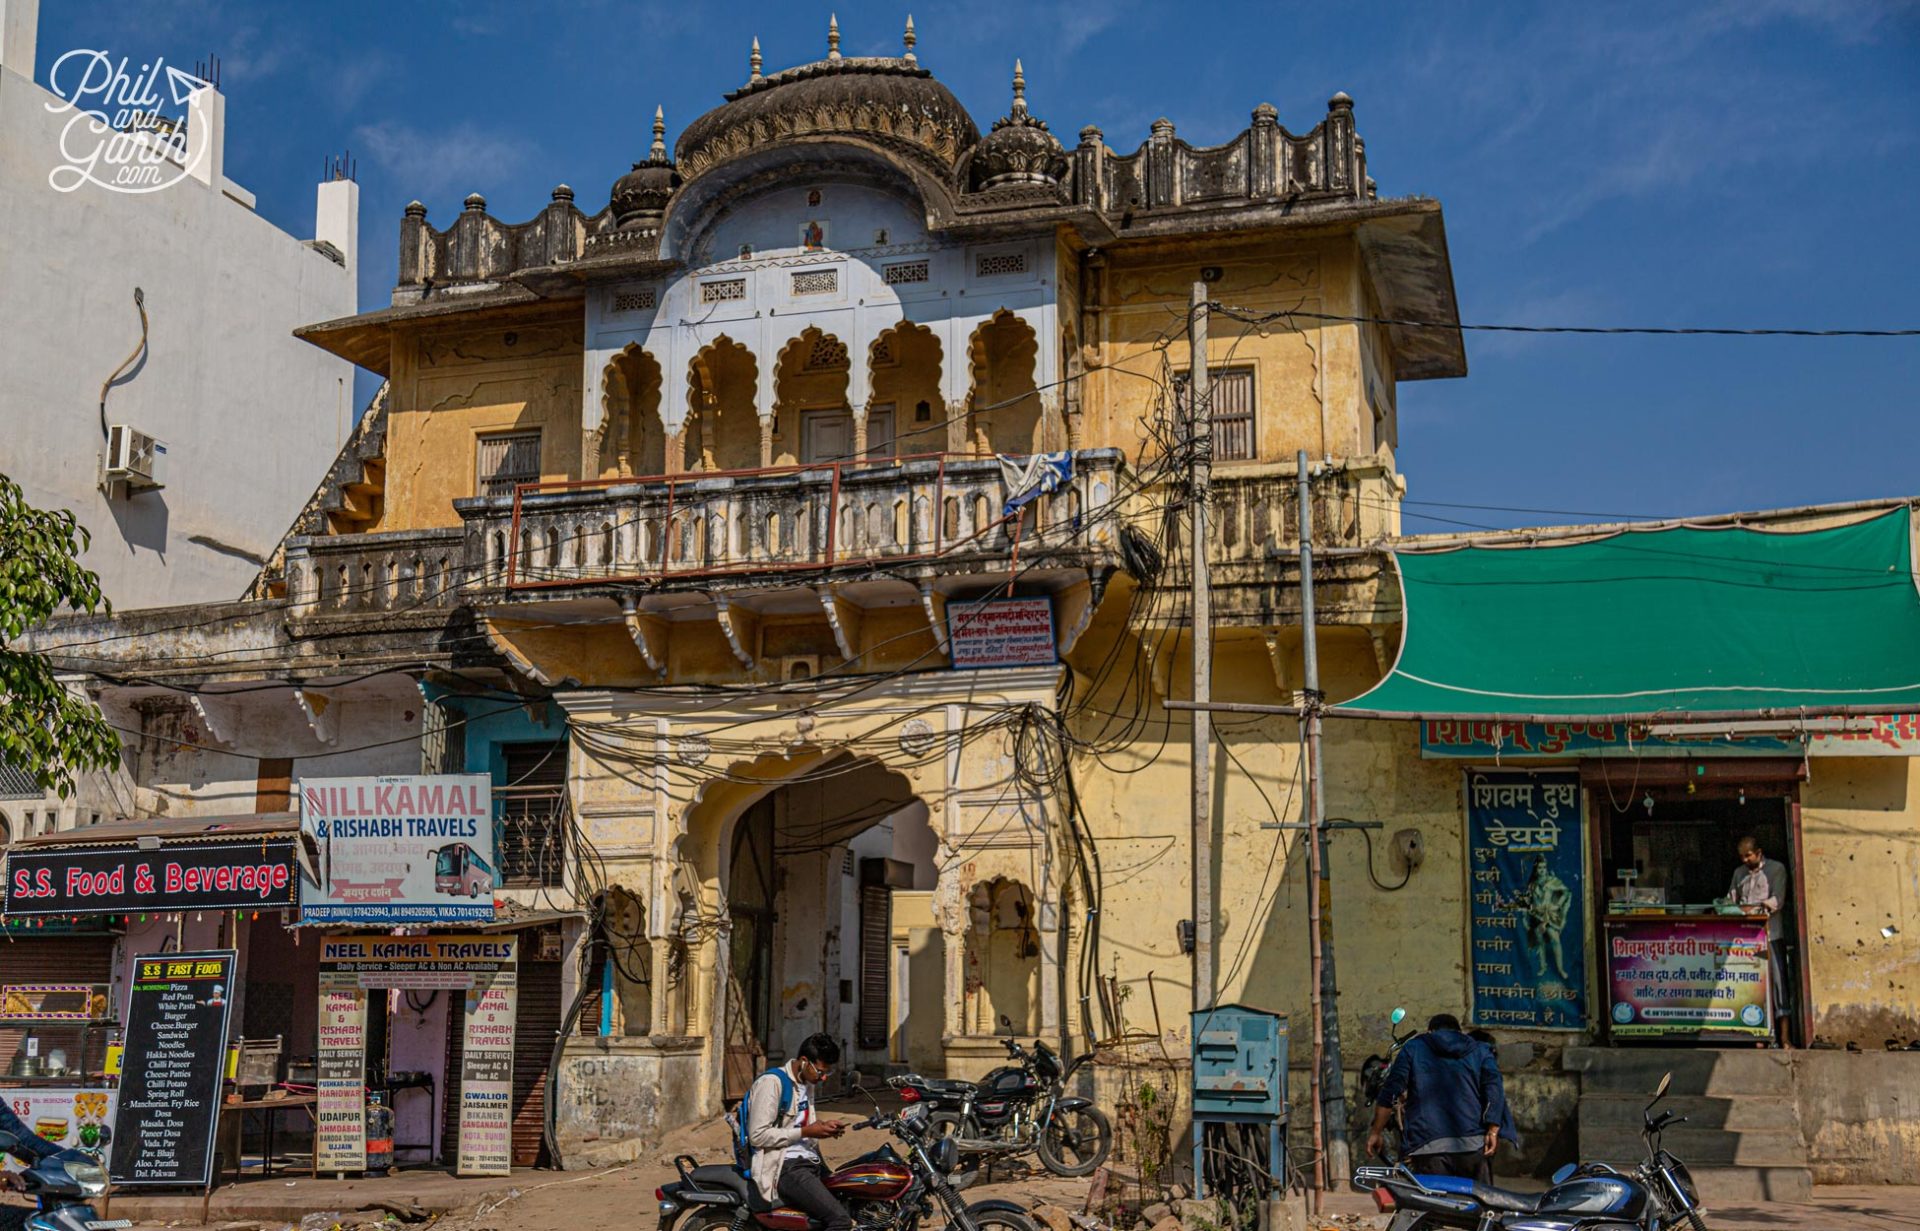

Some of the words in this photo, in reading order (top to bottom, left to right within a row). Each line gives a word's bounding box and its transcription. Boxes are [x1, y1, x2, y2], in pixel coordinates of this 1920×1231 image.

[306, 785, 486, 817] NILLKAMAL
[1472, 774, 1538, 820] शिवम्
[317, 819, 328, 838] &
[334, 819, 403, 838] RISHABH
[407, 818, 477, 837] TRAVELS
[1485, 819, 1562, 846] डेयरी
[13, 867, 57, 899] S.S.
[66, 864, 125, 897] Food
[134, 863, 155, 895] &
[165, 861, 289, 899] Beverage
[304, 907, 330, 917] PRADEEP
[439, 906, 456, 917] VIKAS
[326, 944, 367, 958] NEEL
[373, 944, 432, 958] KAMAL
[438, 943, 511, 958] TRAVELS
[143, 964, 161, 976] S.S
[167, 963, 193, 975] FAST
[195, 963, 222, 974] FOOD
[337, 962, 355, 971] Daily
[357, 962, 383, 970] Service
[390, 962, 416, 971] Sleeper
[418, 962, 428, 970] AC
[430, 962, 436, 970] &
[438, 962, 452, 970] Non
[453, 962, 464, 970] AC
[466, 962, 499, 971] Available
[331, 992, 355, 1000] NEEL
[482, 991, 505, 999] NEEL
[326, 1003, 358, 1012] KAMAL
[477, 1002, 509, 1011] KAMAL
[165, 1012, 187, 1020] Burger
[338, 1015, 345, 1023] &
[488, 1014, 495, 1022] &
[321, 1026, 362, 1034] RISHABH
[469, 1025, 512, 1034] RISHABH
[159, 1041, 186, 1049] Noodles
[322, 1037, 360, 1046] TRAVELS
[470, 1037, 511, 1045] TRAVELS
[146, 1051, 167, 1059] Hakka
[168, 1051, 196, 1059] Noodles
[319, 1050, 335, 1058] DAILY
[484, 1052, 511, 1060] SERVICE
[148, 1061, 167, 1069] Chilli
[168, 1061, 191, 1069] Paneer
[321, 1060, 344, 1069] Sleeper
[345, 1060, 353, 1068] AC
[467, 1062, 491, 1070] Sleeper
[492, 1062, 502, 1070] AC
[503, 1062, 508, 1070] &
[145, 1070, 169, 1078] Cheese
[170, 1070, 191, 1078] Patties
[330, 1070, 341, 1078] Non
[476, 1072, 488, 1080] Non
[490, 1072, 499, 1080] AC
[147, 1080, 166, 1088] Chilli
[167, 1080, 187, 1088] Potato
[148, 1090, 169, 1099] Spring
[320, 1089, 361, 1097] HARIDWAR
[465, 1092, 508, 1100] GWALIOR
[13, 1100, 31, 1116] S.S
[171, 1100, 183, 1109] Fry
[320, 1113, 360, 1121] UDAIPUR
[467, 1112, 503, 1120] BIKANER
[320, 1125, 362, 1133] AHMDABAD
[462, 1121, 508, 1129] GANGANAGAR
[157, 1149, 175, 1159] Bhaji
